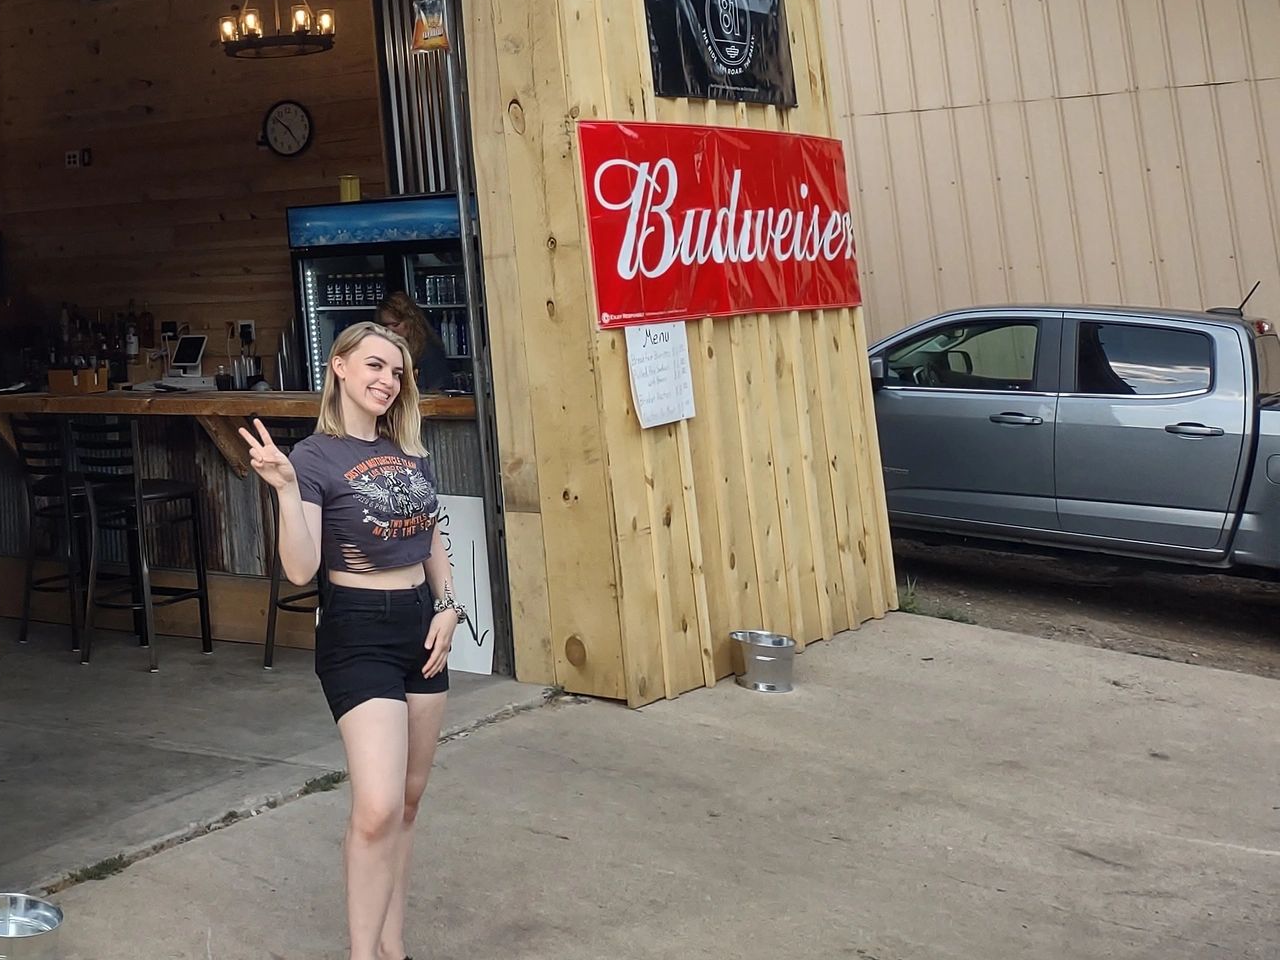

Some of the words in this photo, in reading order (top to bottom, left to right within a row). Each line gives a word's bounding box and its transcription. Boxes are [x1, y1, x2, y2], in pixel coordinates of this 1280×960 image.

[594, 158, 856, 280] Budweiser
[642, 328, 670, 348] Menu
[401, 524, 417, 537] THE
